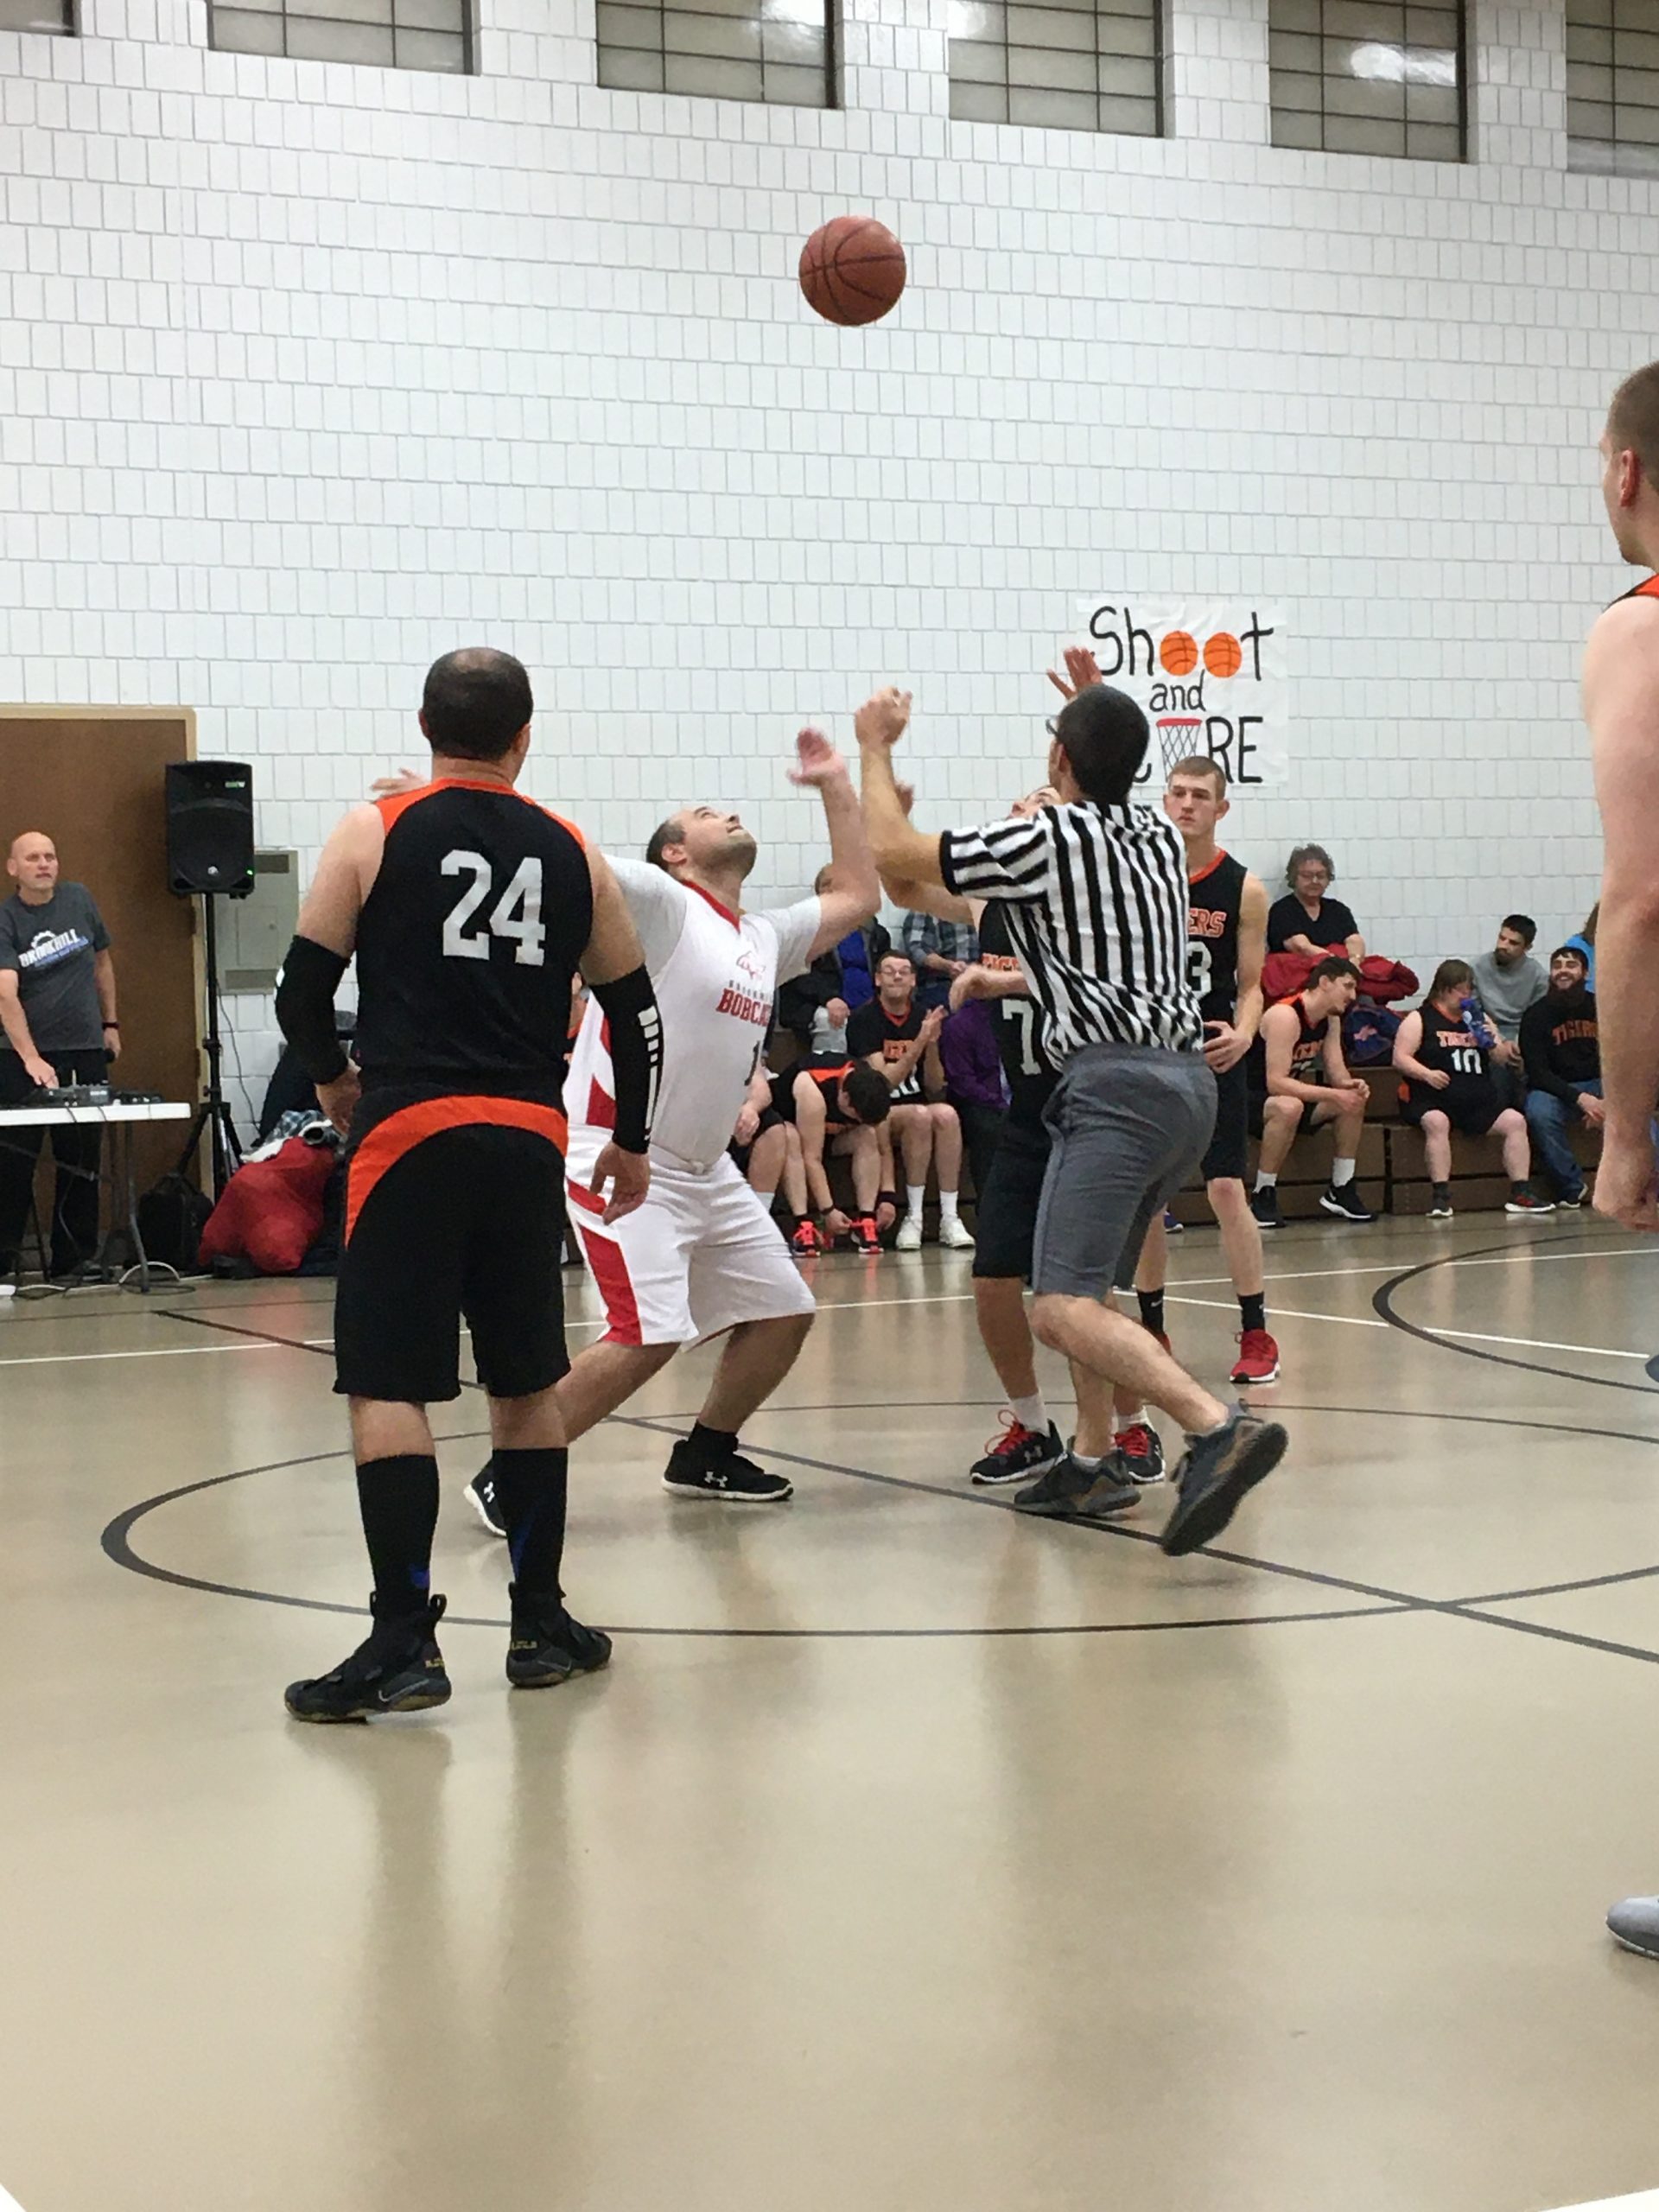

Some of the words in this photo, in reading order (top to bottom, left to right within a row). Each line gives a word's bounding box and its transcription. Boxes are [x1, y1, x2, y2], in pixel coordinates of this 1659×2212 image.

[1149, 669, 1206, 713] and
[441, 849, 546, 967] 24
[1188, 907, 1227, 938] ERS
[1002, 998, 1042, 1075] 7
[1451, 1048, 1483, 1074] 10
